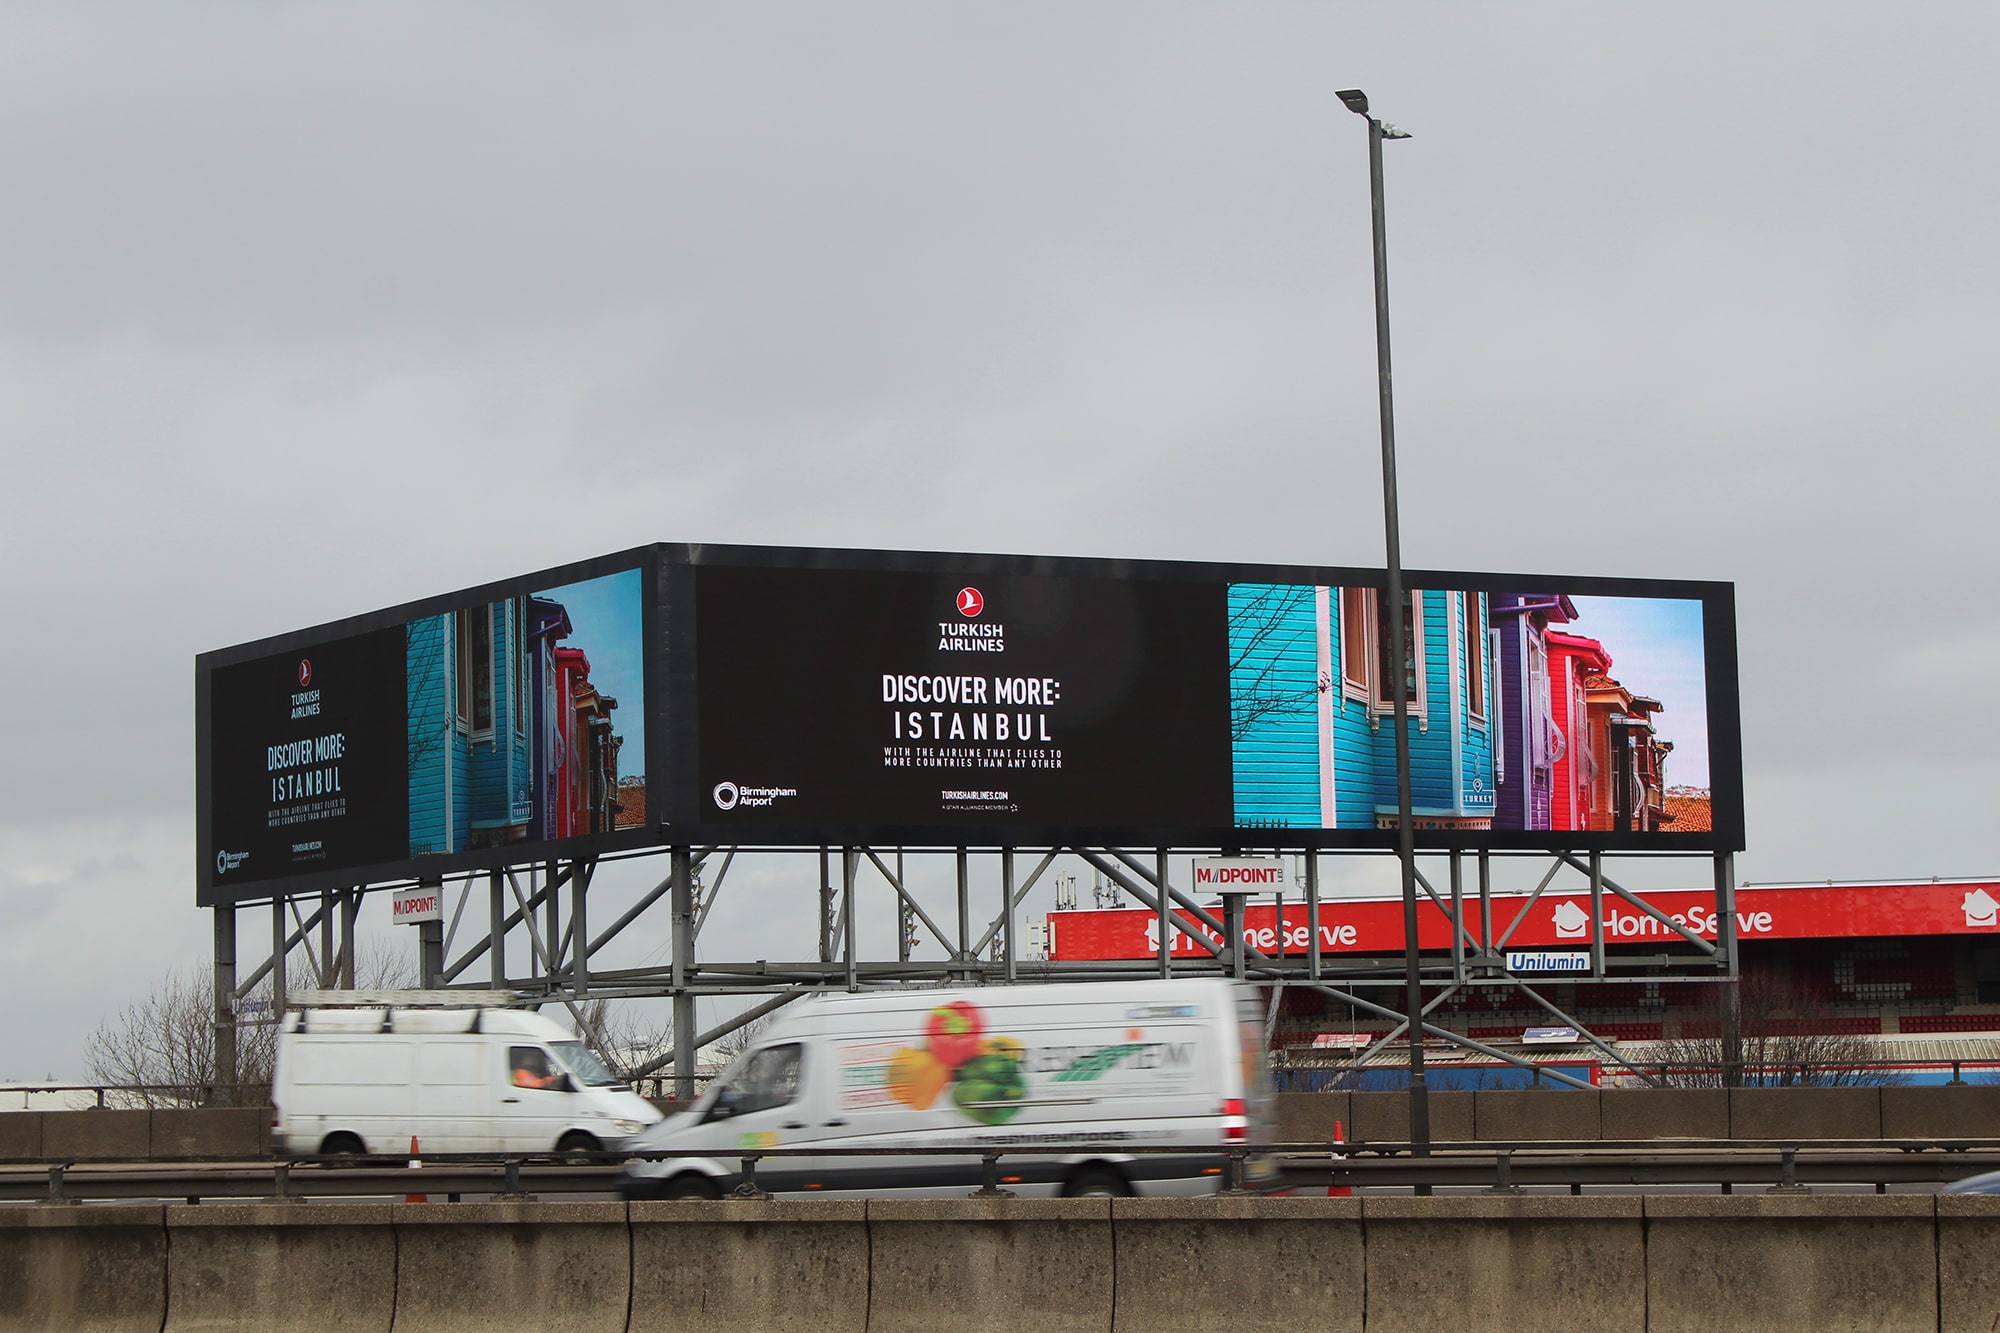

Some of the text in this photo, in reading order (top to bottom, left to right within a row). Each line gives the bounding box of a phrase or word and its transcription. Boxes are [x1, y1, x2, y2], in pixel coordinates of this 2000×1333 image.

[938, 622, 1004, 637] TURKISH
[938, 637, 1005, 652] AIRLINES
[291, 689, 320, 706] TURKISH
[882, 674, 1061, 706] DISCOVER MORE:
[291, 702, 320, 720] AIRLINES
[894, 711, 1052, 741] ISTANBUL
[267, 732, 345, 771] DISCOVER MORE:
[884, 747, 1062, 759] WITH THE AIRLINE THAT FLIES TO
[884, 757, 1062, 769] MORE COUNTRIES THAN ANY OTHER
[272, 766, 341, 802] ISTANBUL
[740, 786, 797, 799] Birmingham
[941, 790, 1009, 800] TURKISHAIRLINES.COM
[1464, 795, 1493, 803] TURKEY
[740, 796, 773, 808] Airport
[1602, 906, 1773, 937] HomeSeve
[1511, 953, 1586, 970] Unilumin
